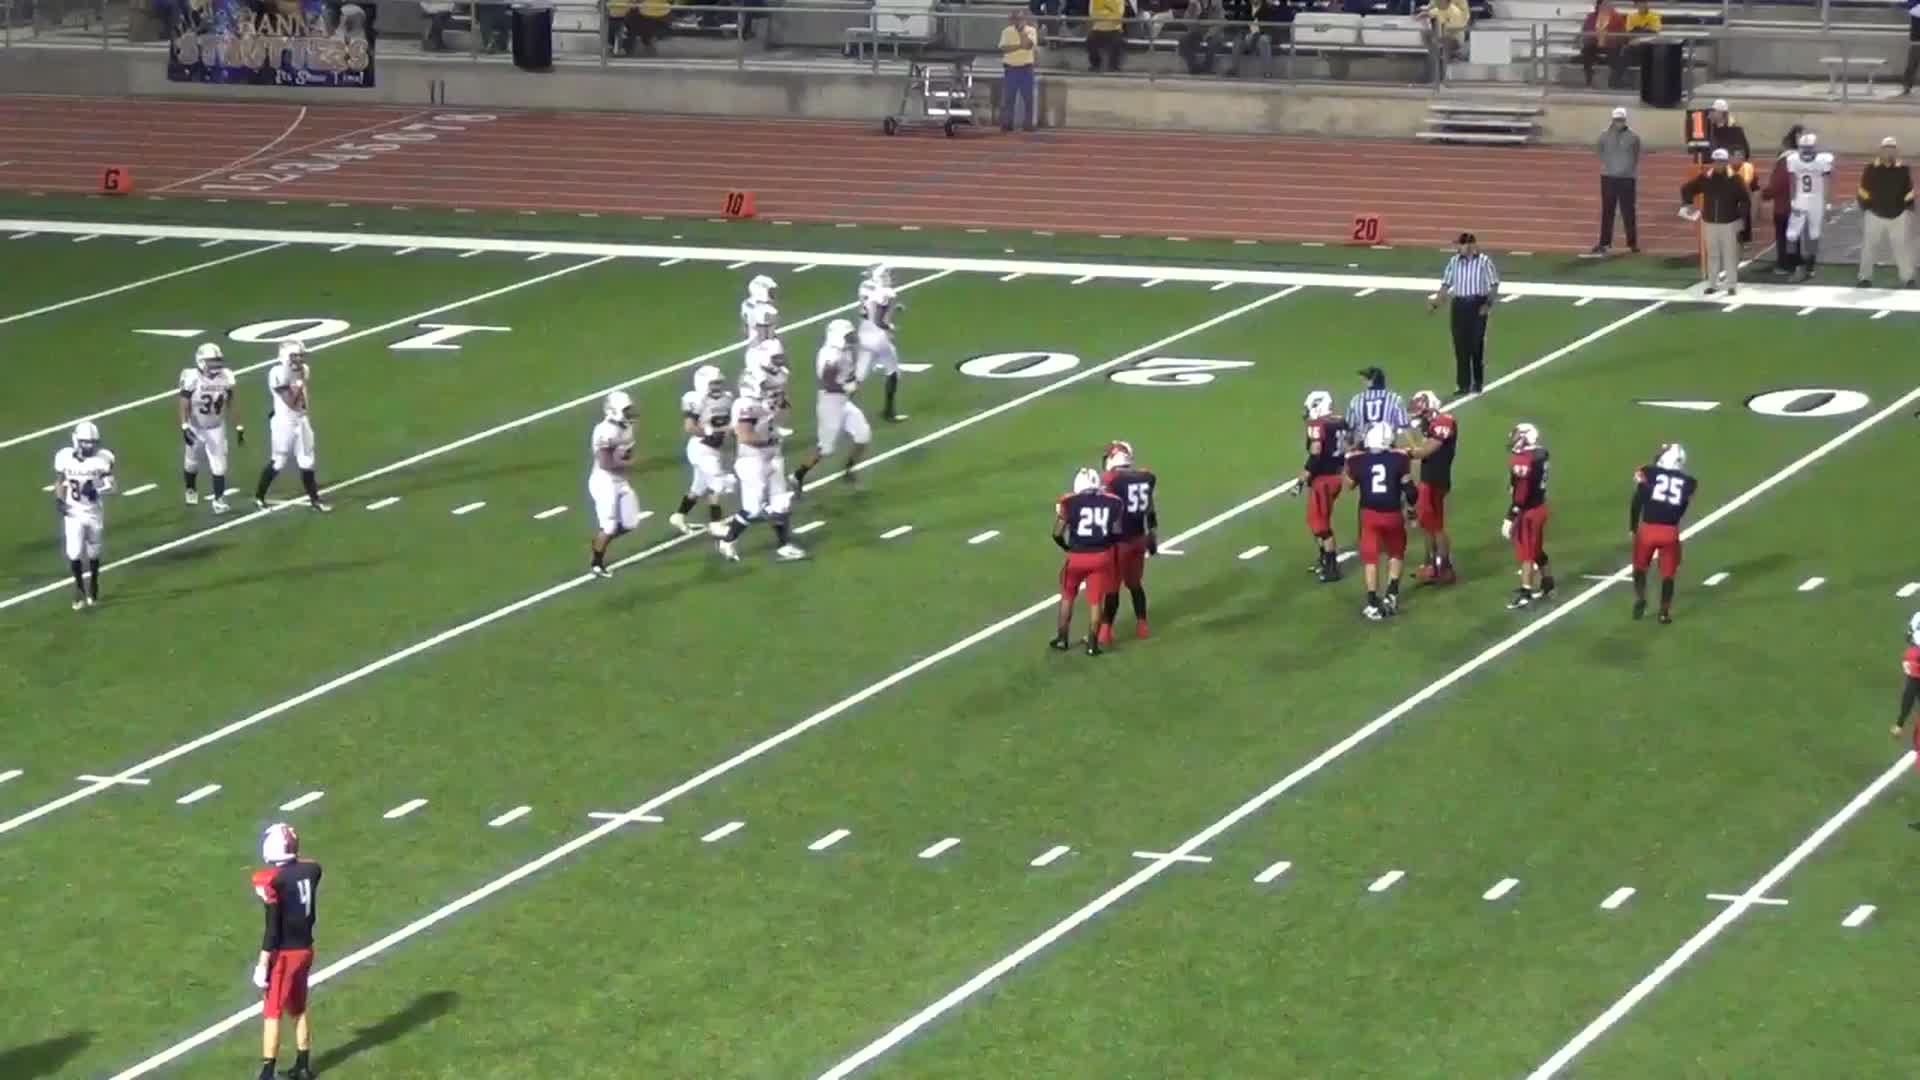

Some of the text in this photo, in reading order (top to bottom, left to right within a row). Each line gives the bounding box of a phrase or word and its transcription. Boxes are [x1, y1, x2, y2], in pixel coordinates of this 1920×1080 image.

[1691, 111, 1705, 139] 1
[104, 167, 121, 191] G
[1802, 174, 1813, 194] 9
[726, 192, 745, 217] 10
[1353, 217, 1378, 241] 20
[1365, 400, 1383, 422] U
[1370, 462, 1388, 493] 2
[1651, 473, 1685, 506] 25
[1127, 482, 1150, 513] 55
[1076, 506, 1110, 537] 24
[296, 878, 311, 918] 4
